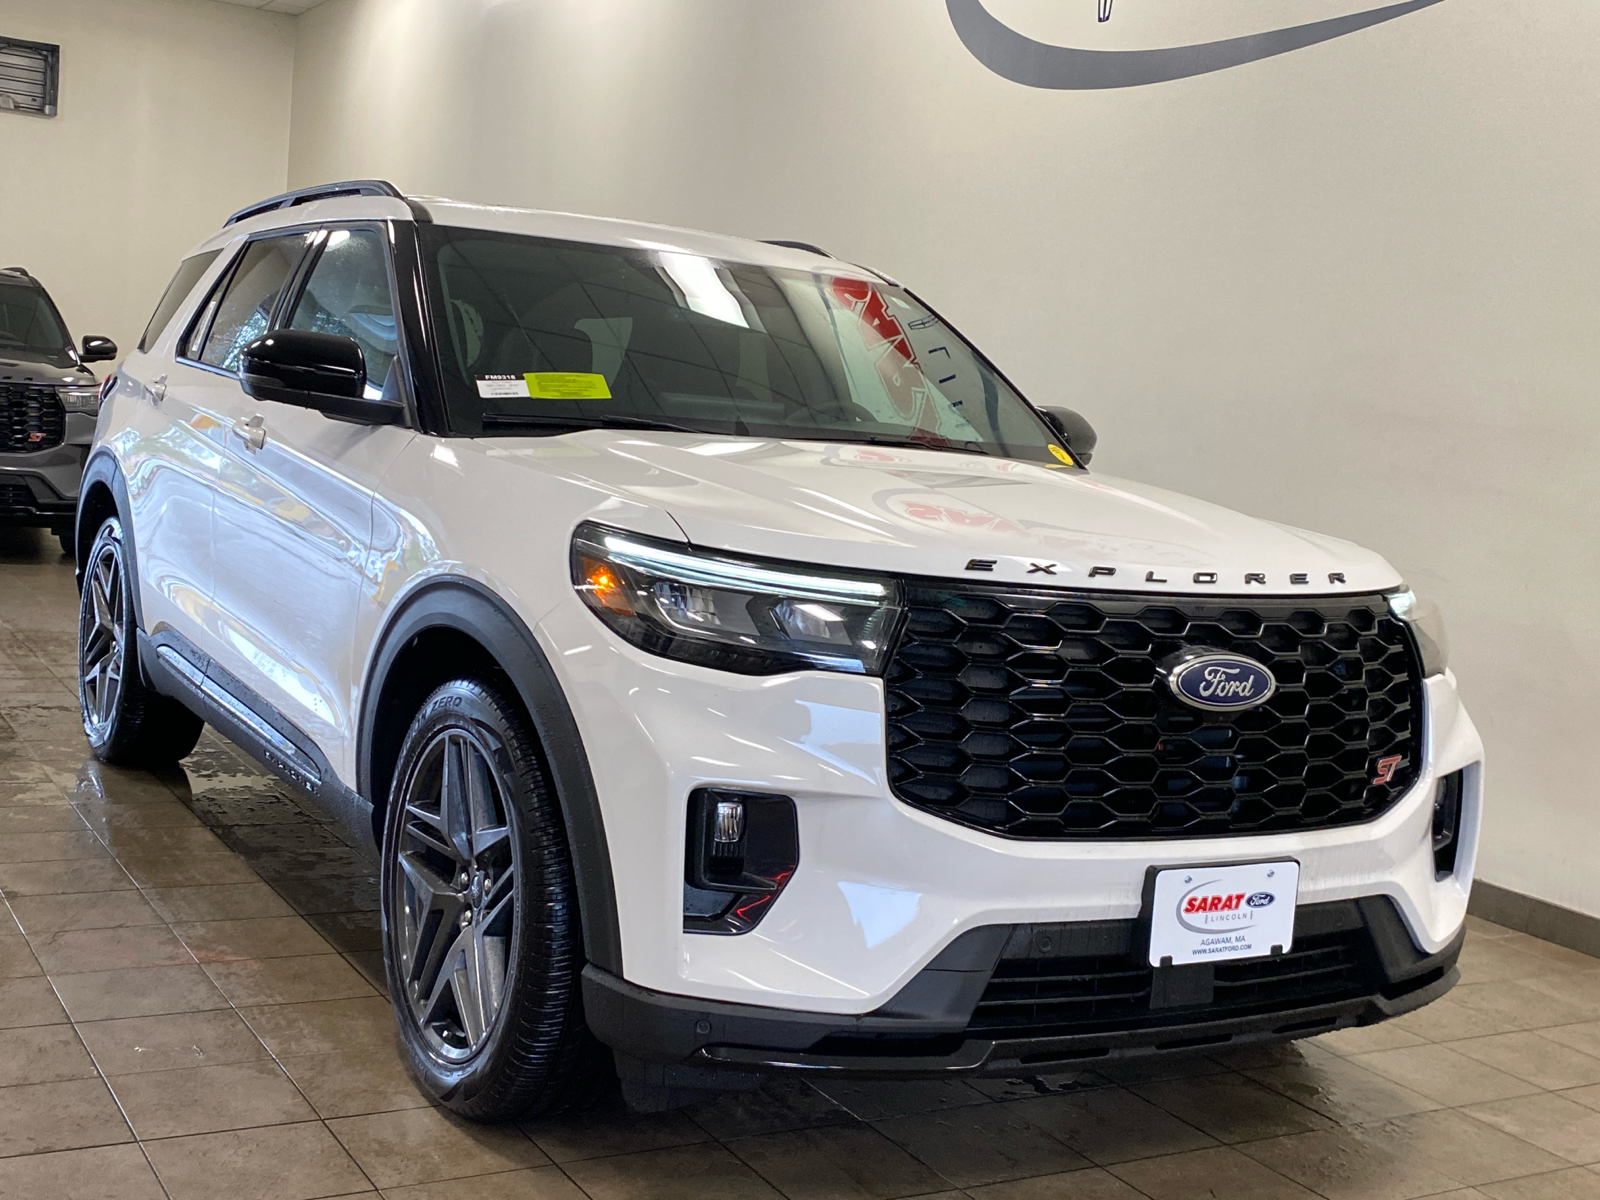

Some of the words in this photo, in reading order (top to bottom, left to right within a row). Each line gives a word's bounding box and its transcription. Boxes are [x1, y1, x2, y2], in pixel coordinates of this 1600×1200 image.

[964, 558, 1347, 586] EXPLORER
[1199, 666, 1255, 698] Ford
[431, 695, 463, 711] ZERO
[1372, 754, 1402, 785] ST
[1183, 893, 1246, 913] SARAT
[1249, 894, 1271, 906] Ford
[1211, 913, 1247, 922] LINCOLN
[1192, 944, 1252, 955] WWW.SARATFORD.COM
[1201, 936, 1233, 946] AGAWAM,
[1235, 935, 1246, 943] MA
